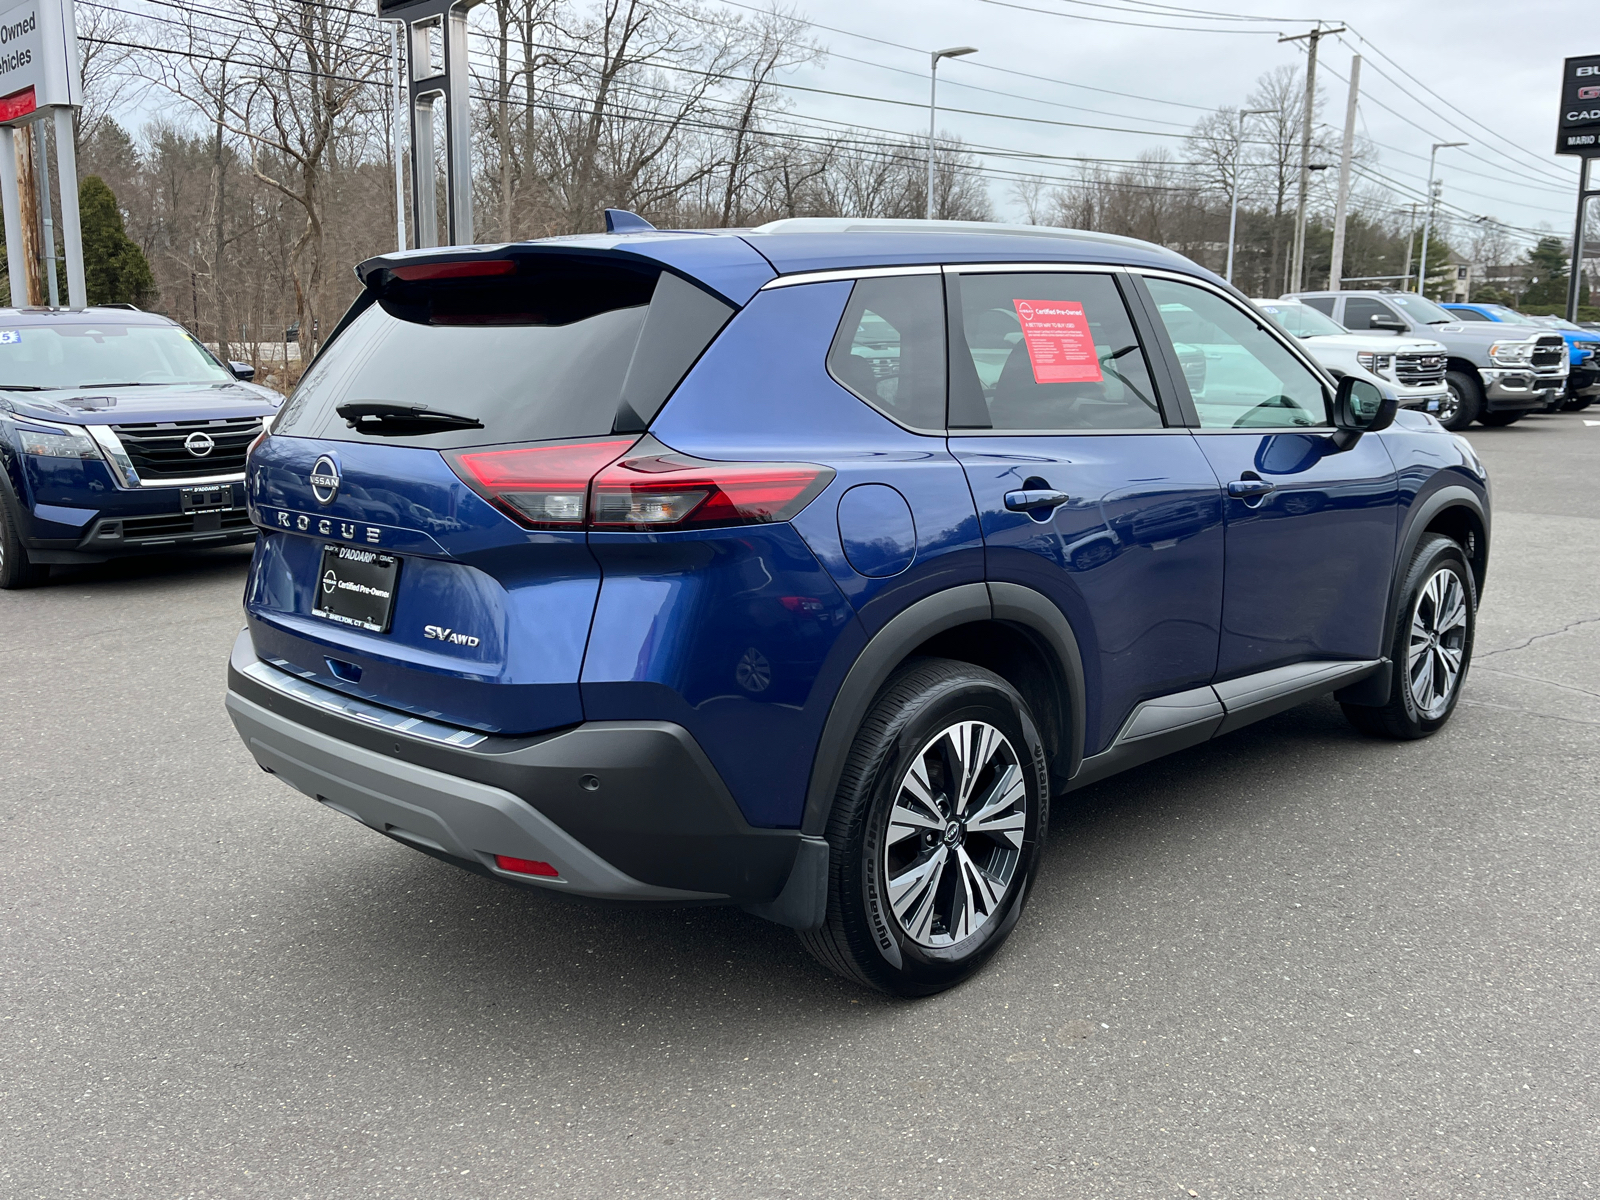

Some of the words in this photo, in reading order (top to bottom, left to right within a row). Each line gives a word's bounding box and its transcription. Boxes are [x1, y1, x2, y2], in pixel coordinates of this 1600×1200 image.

[1, 11, 36, 44] Owned
[1567, 135, 1595, 146] MARIO
[310, 475, 338, 487] SSAN
[277, 511, 381, 543] ROGUE
[339, 547, 376, 563] D'ADDARIO
[338, 580, 360, 592] Certified
[423, 625, 452, 641] SV
[448, 633, 480, 647] AWD
